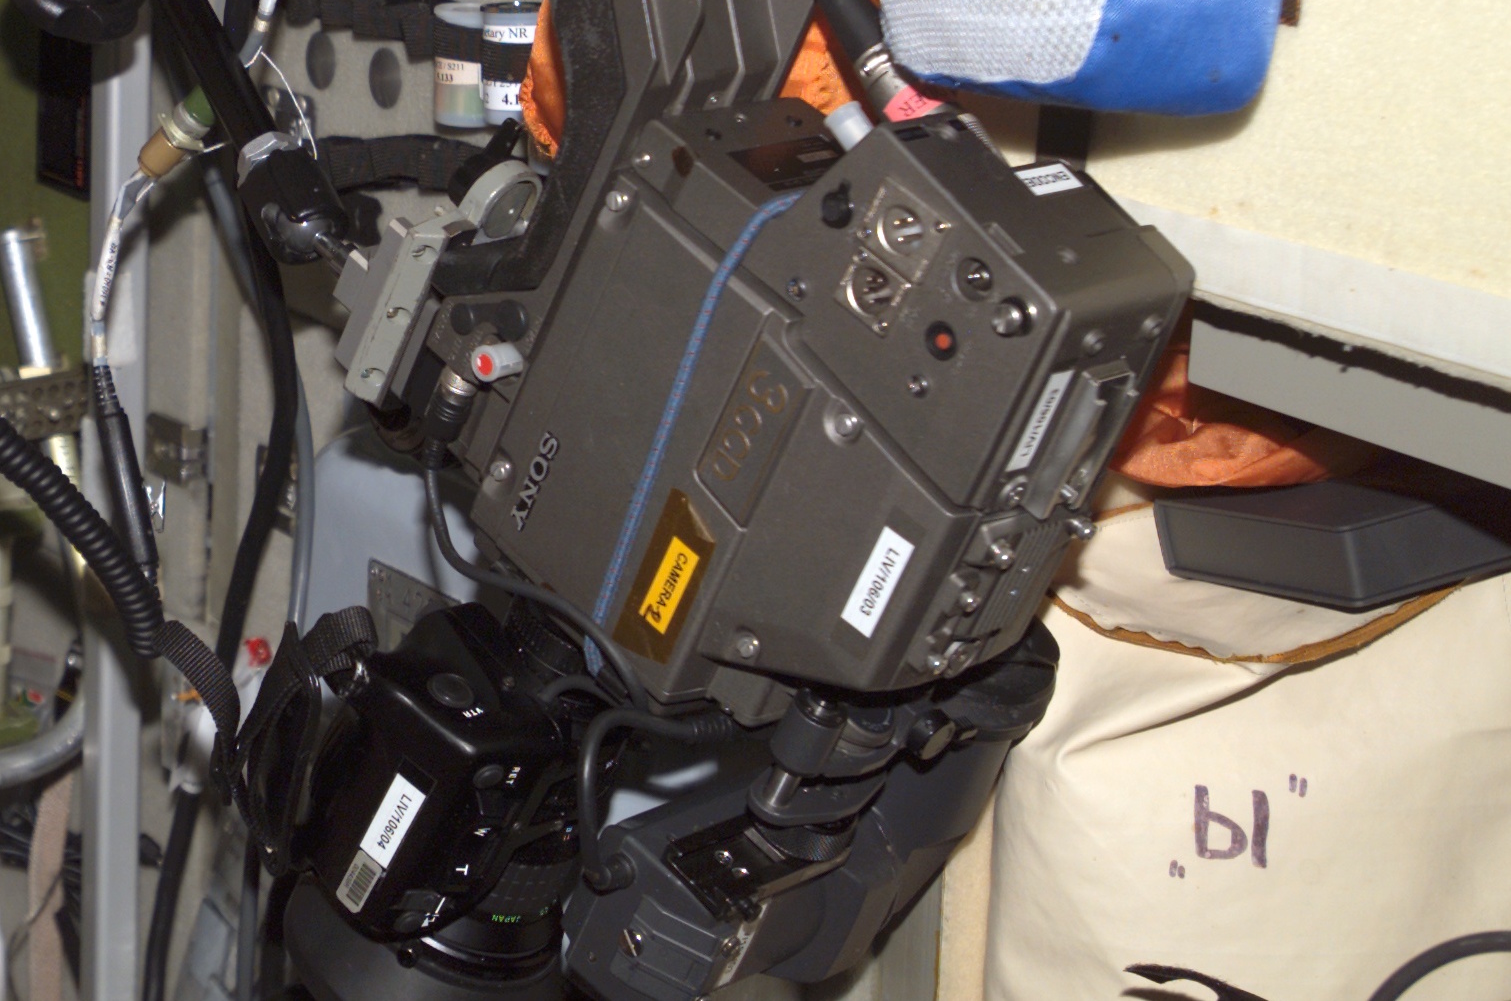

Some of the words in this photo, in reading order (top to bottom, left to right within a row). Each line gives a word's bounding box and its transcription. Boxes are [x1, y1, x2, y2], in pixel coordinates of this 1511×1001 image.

[508, 27, 528, 39] NR
[510, 431, 558, 532] SONY
[859, 547, 900, 616] LIV/106/03
[377, 793, 413, 850] LIV/106/04
